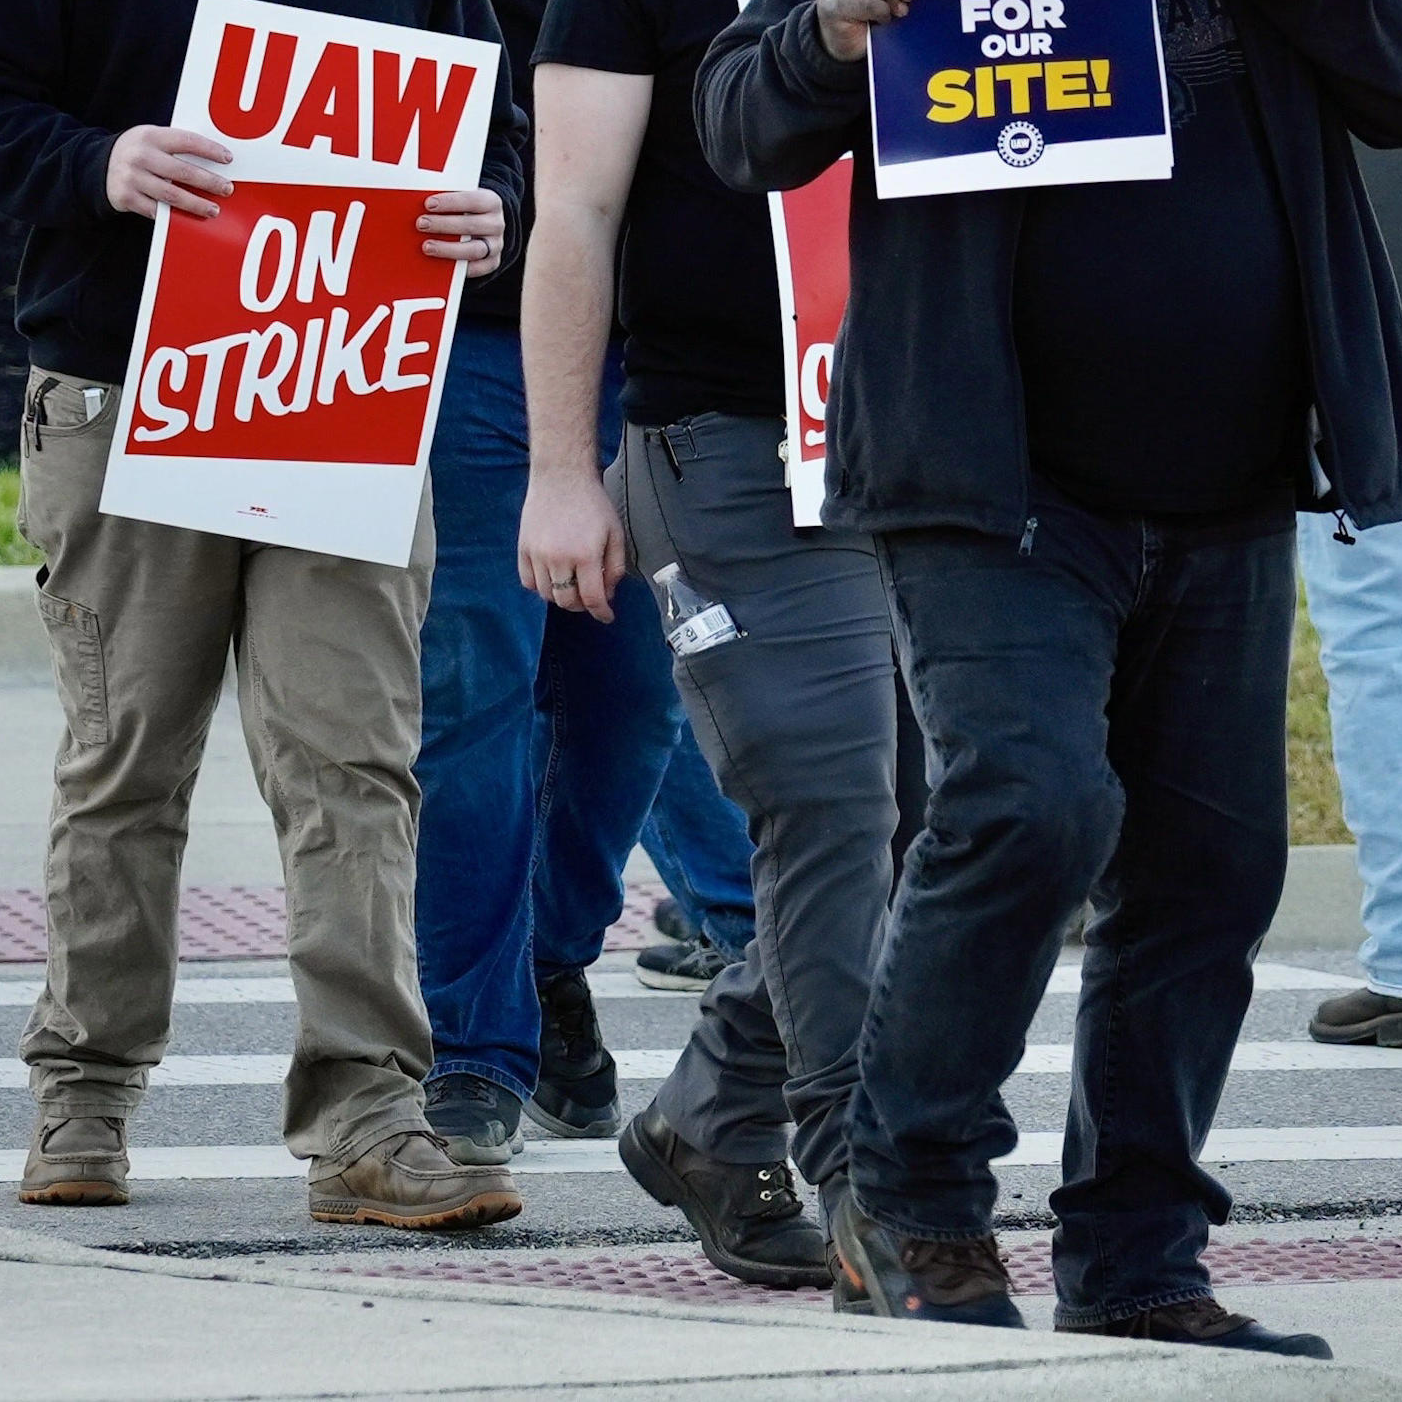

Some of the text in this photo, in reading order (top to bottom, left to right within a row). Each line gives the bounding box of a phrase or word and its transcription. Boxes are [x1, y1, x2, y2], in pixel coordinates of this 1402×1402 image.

[208, 24, 477, 172] UAW
[925, 59, 1113, 124] SITE!
[980, 32, 1054, 58] OUR
[239, 200, 366, 313] ON
[134, 297, 446, 442] STRIKE
